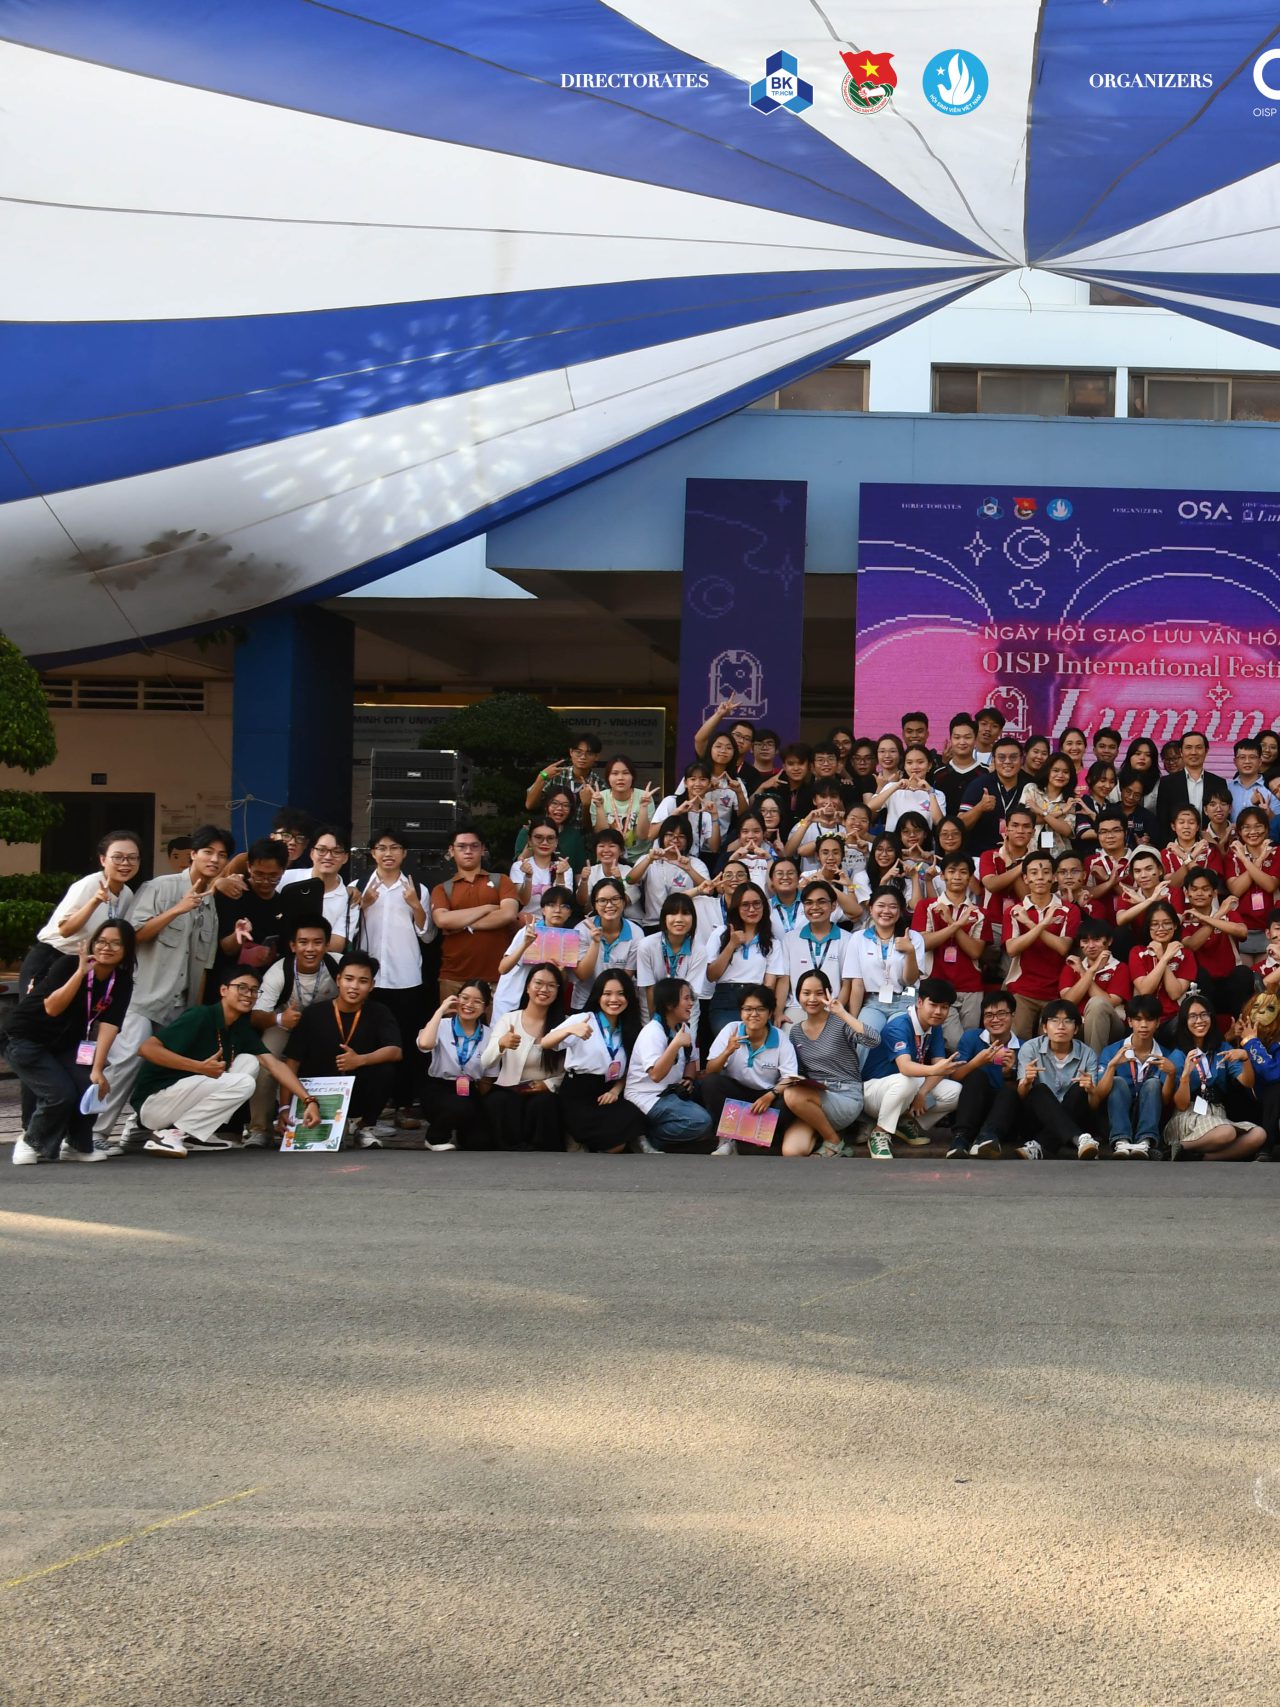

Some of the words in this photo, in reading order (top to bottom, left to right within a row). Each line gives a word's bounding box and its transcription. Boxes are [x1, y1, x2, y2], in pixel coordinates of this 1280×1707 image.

[1178, 500, 1232, 520] OSA
[984, 624, 1040, 640] NGÀY
[1047, 625, 1085, 644] HỘI
[1093, 627, 1146, 643] GIAO
[1153, 628, 1192, 643] LƯU
[1200, 628, 1240, 644] VĂN
[982, 651, 1049, 674] OISP
[1057, 653, 1220, 677] International
[384, 716, 405, 724] CITY
[561, 718, 601, 728] HCMUT)
